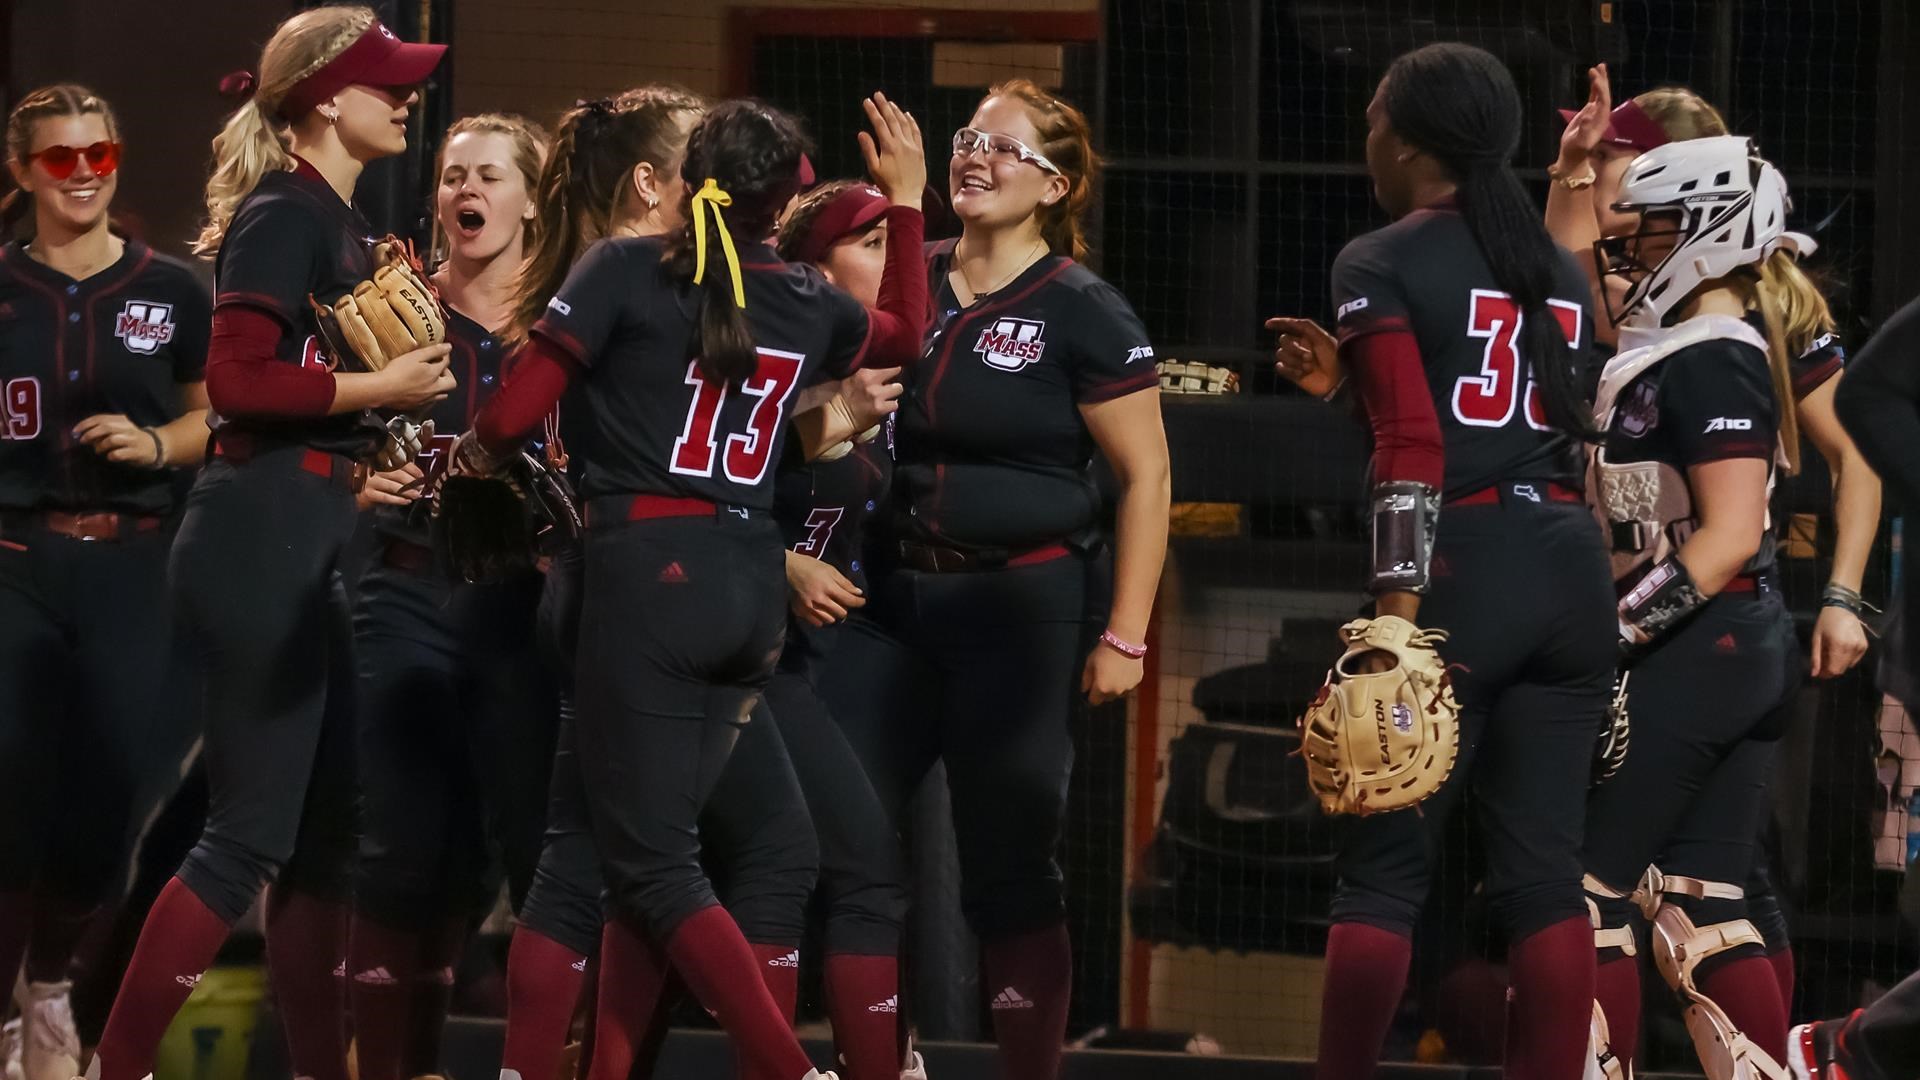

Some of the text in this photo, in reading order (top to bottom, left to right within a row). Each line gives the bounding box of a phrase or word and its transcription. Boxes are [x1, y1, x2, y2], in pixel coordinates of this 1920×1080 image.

[116, 314, 176, 344] MASS
[400, 289, 435, 342] EASTON
[975, 329, 1045, 362] MASS
[0, 376, 42, 441] 9
[669, 346, 806, 486] 13
[1703, 416, 1753, 434] A10
[792, 506, 845, 561] 3
[1375, 699, 1391, 765] EASTON
